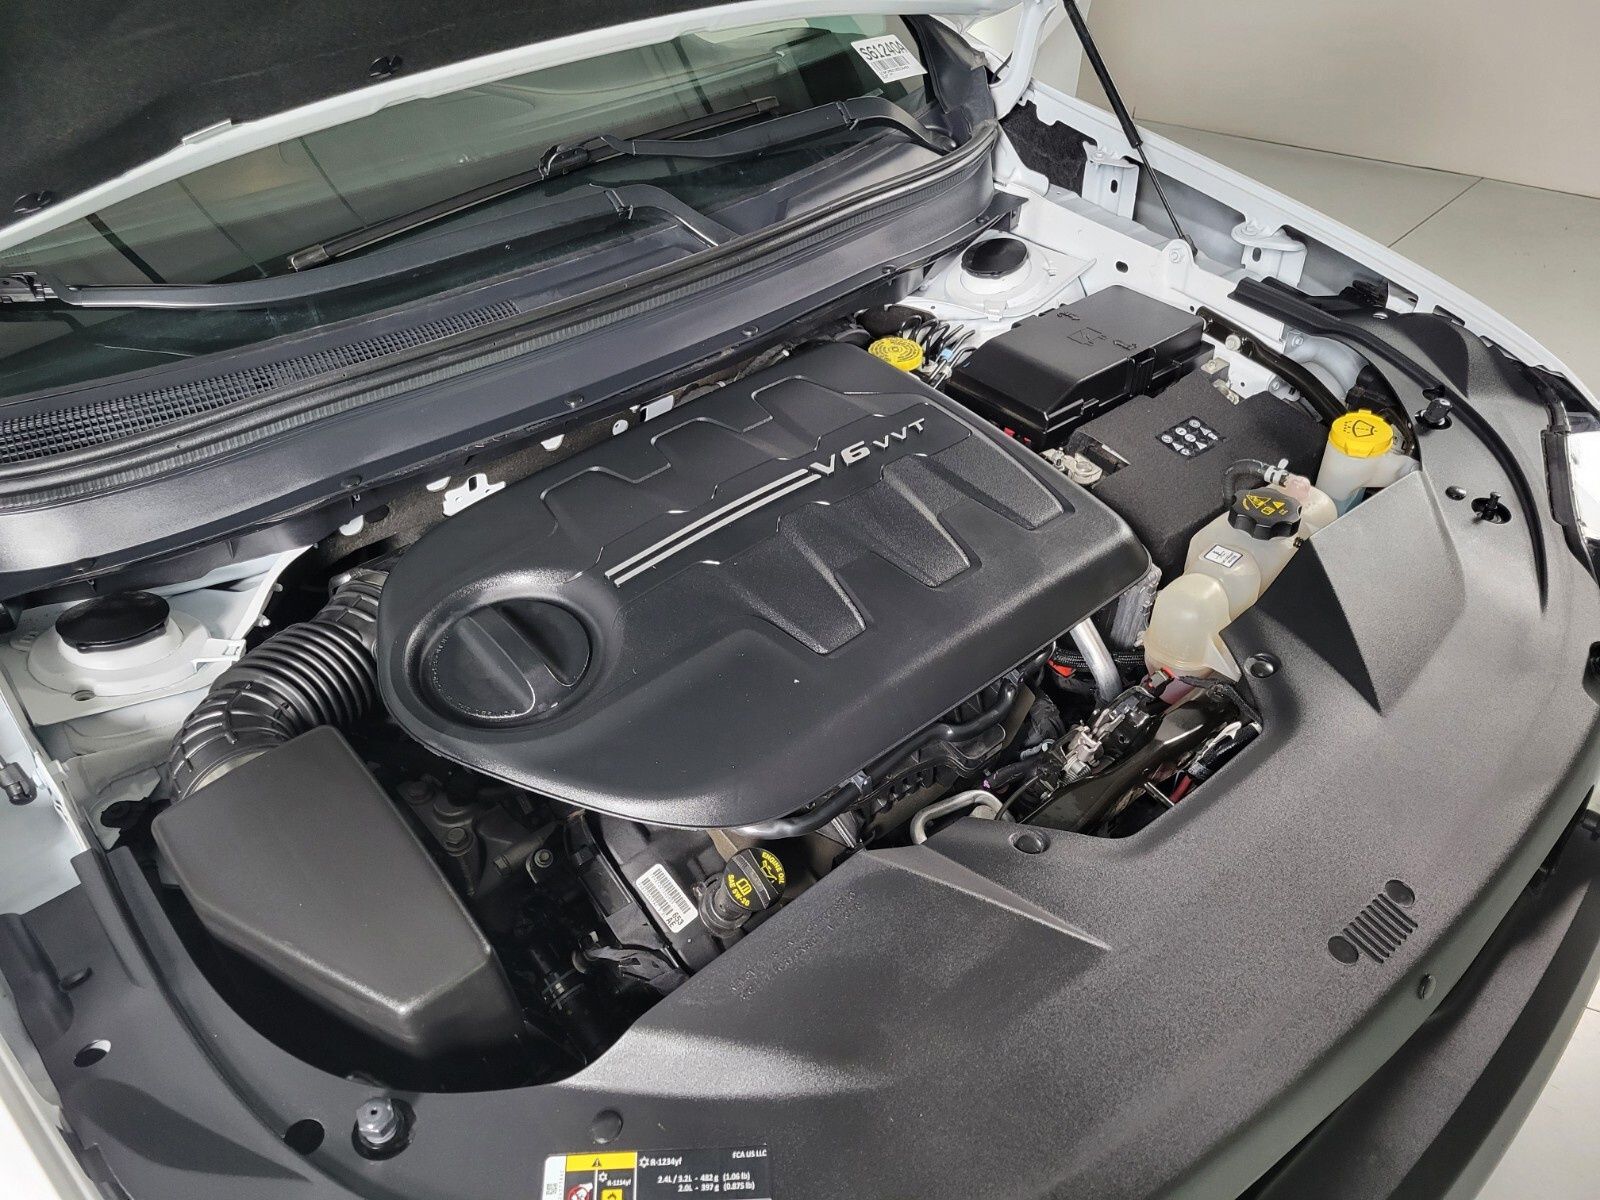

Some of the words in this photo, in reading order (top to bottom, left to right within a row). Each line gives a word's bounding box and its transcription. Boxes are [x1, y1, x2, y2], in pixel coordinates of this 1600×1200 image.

[860, 40, 905, 60] S61240A
[810, 440, 870, 475] V6
[873, 418, 924, 450] VVT
[762, 851, 782, 872] ENGINE
[728, 874, 736, 888] SAE
[732, 1150, 745, 1159] FCA
[746, 1150, 755, 1158] US
[756, 1149, 767, 1157] LLC
[650, 1157, 682, 1167] R-1234yf
[657, 1175, 673, 1184] 2.4L
